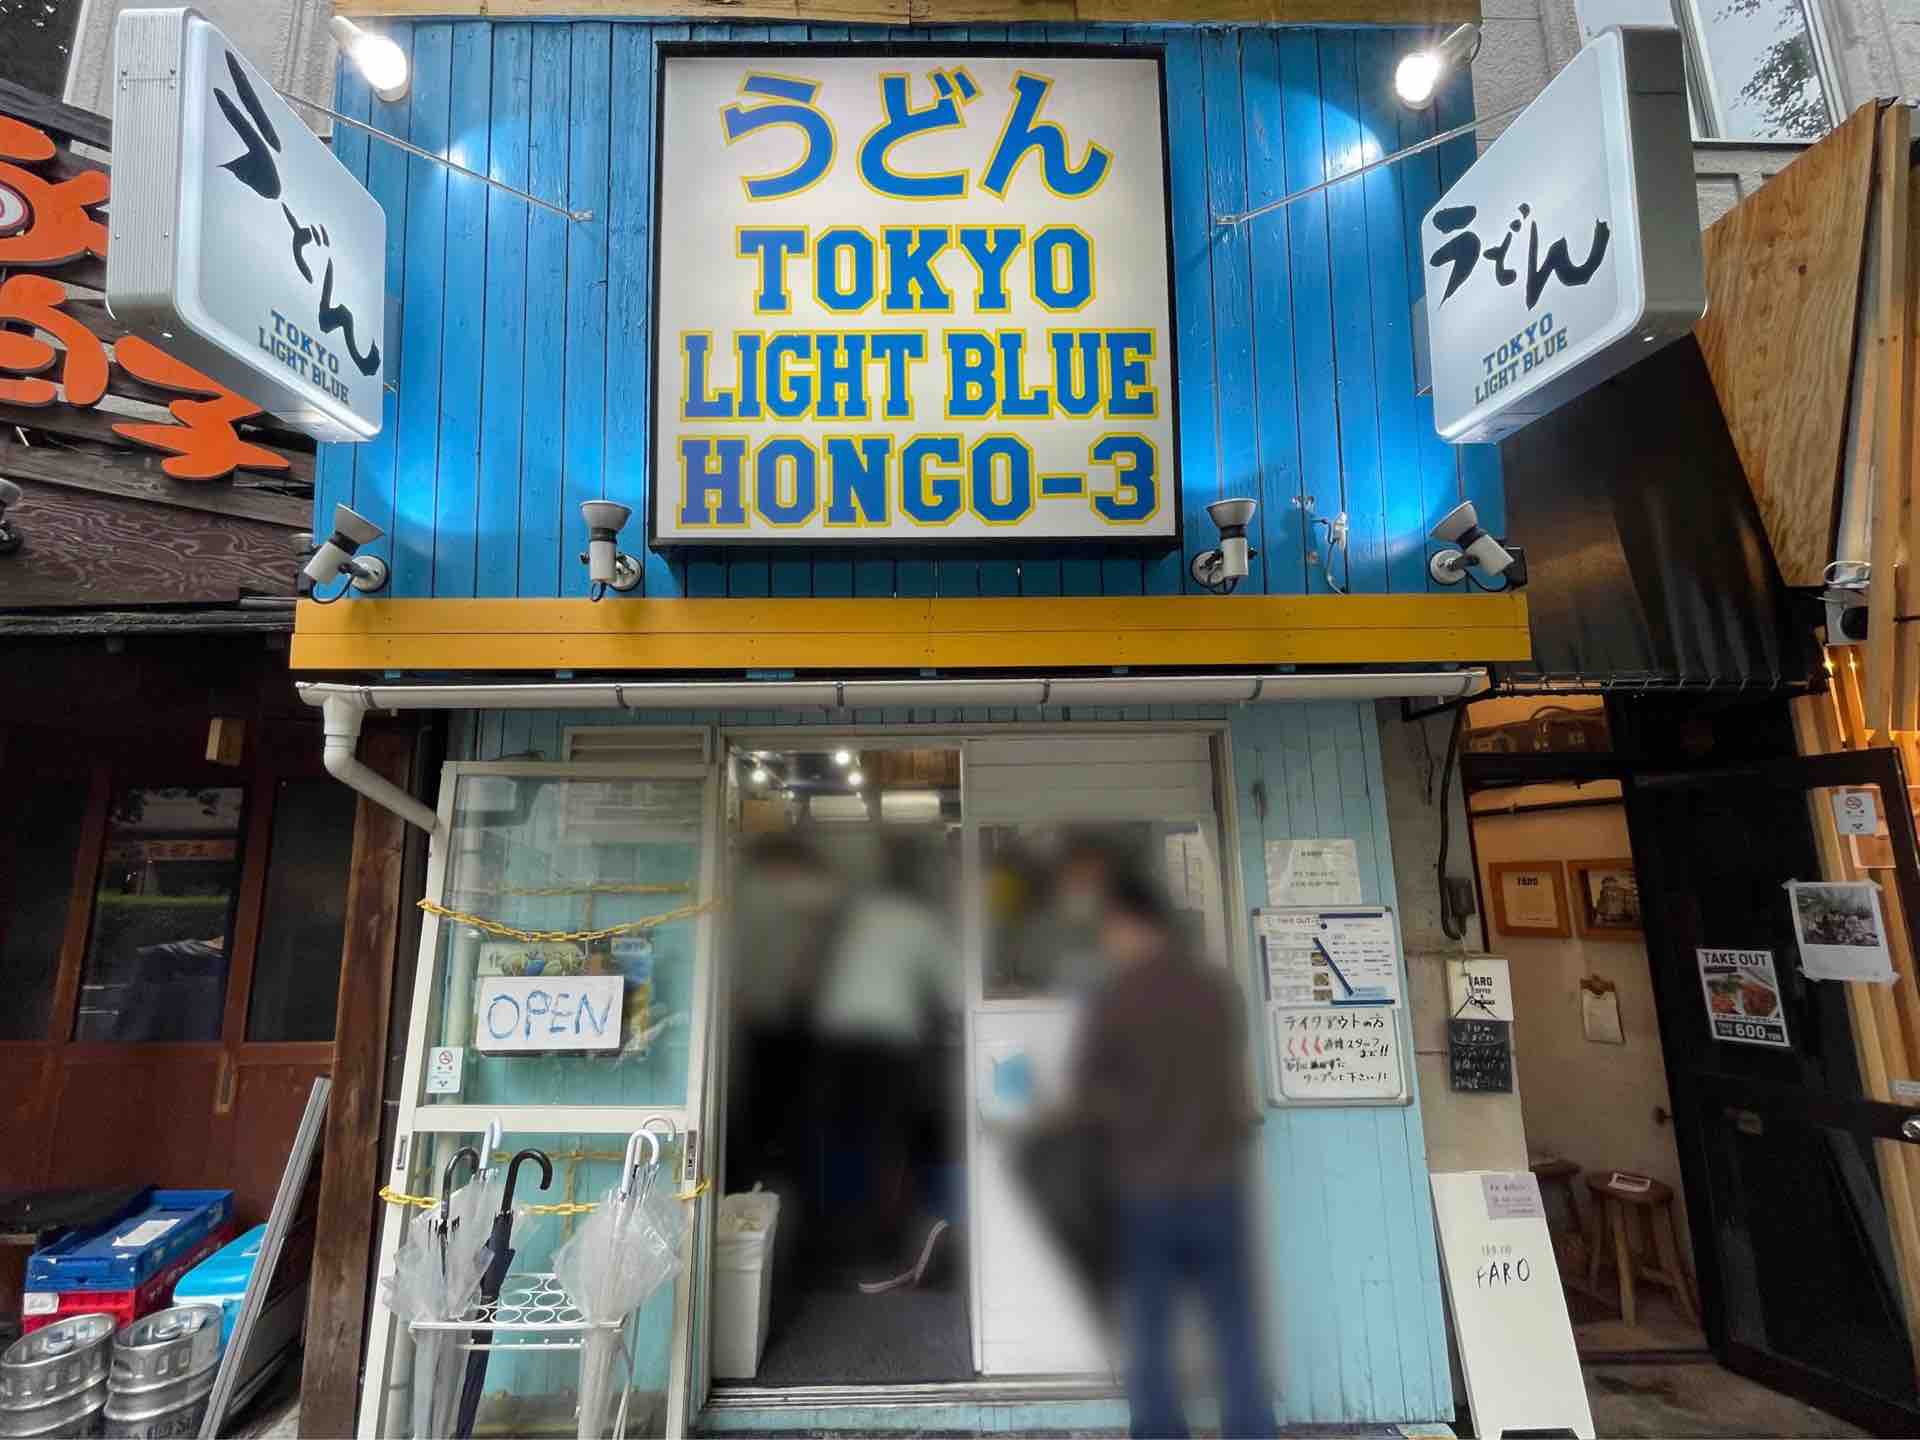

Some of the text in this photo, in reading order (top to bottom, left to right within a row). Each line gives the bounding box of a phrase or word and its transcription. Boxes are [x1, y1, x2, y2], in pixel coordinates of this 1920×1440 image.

[719, 64, 1114, 202] うどん
[736, 224, 1096, 315] TOKYO
[1430, 203, 1610, 311] うどん
[258, 327, 350, 405] LIGHT BLUE
[271, 310, 340, 375] TOKYO
[680, 328, 1159, 422] LIGHT BLUE
[1474, 327, 1568, 405] LIGHT BLUE
[1482, 313, 1553, 373] TOKYO
[676, 432, 1160, 529] HONGO-3
[1703, 952, 1768, 967] TAKE OUT
[488, 990, 614, 1040] OPEN
[1735, 1023, 1766, 1039] 600
